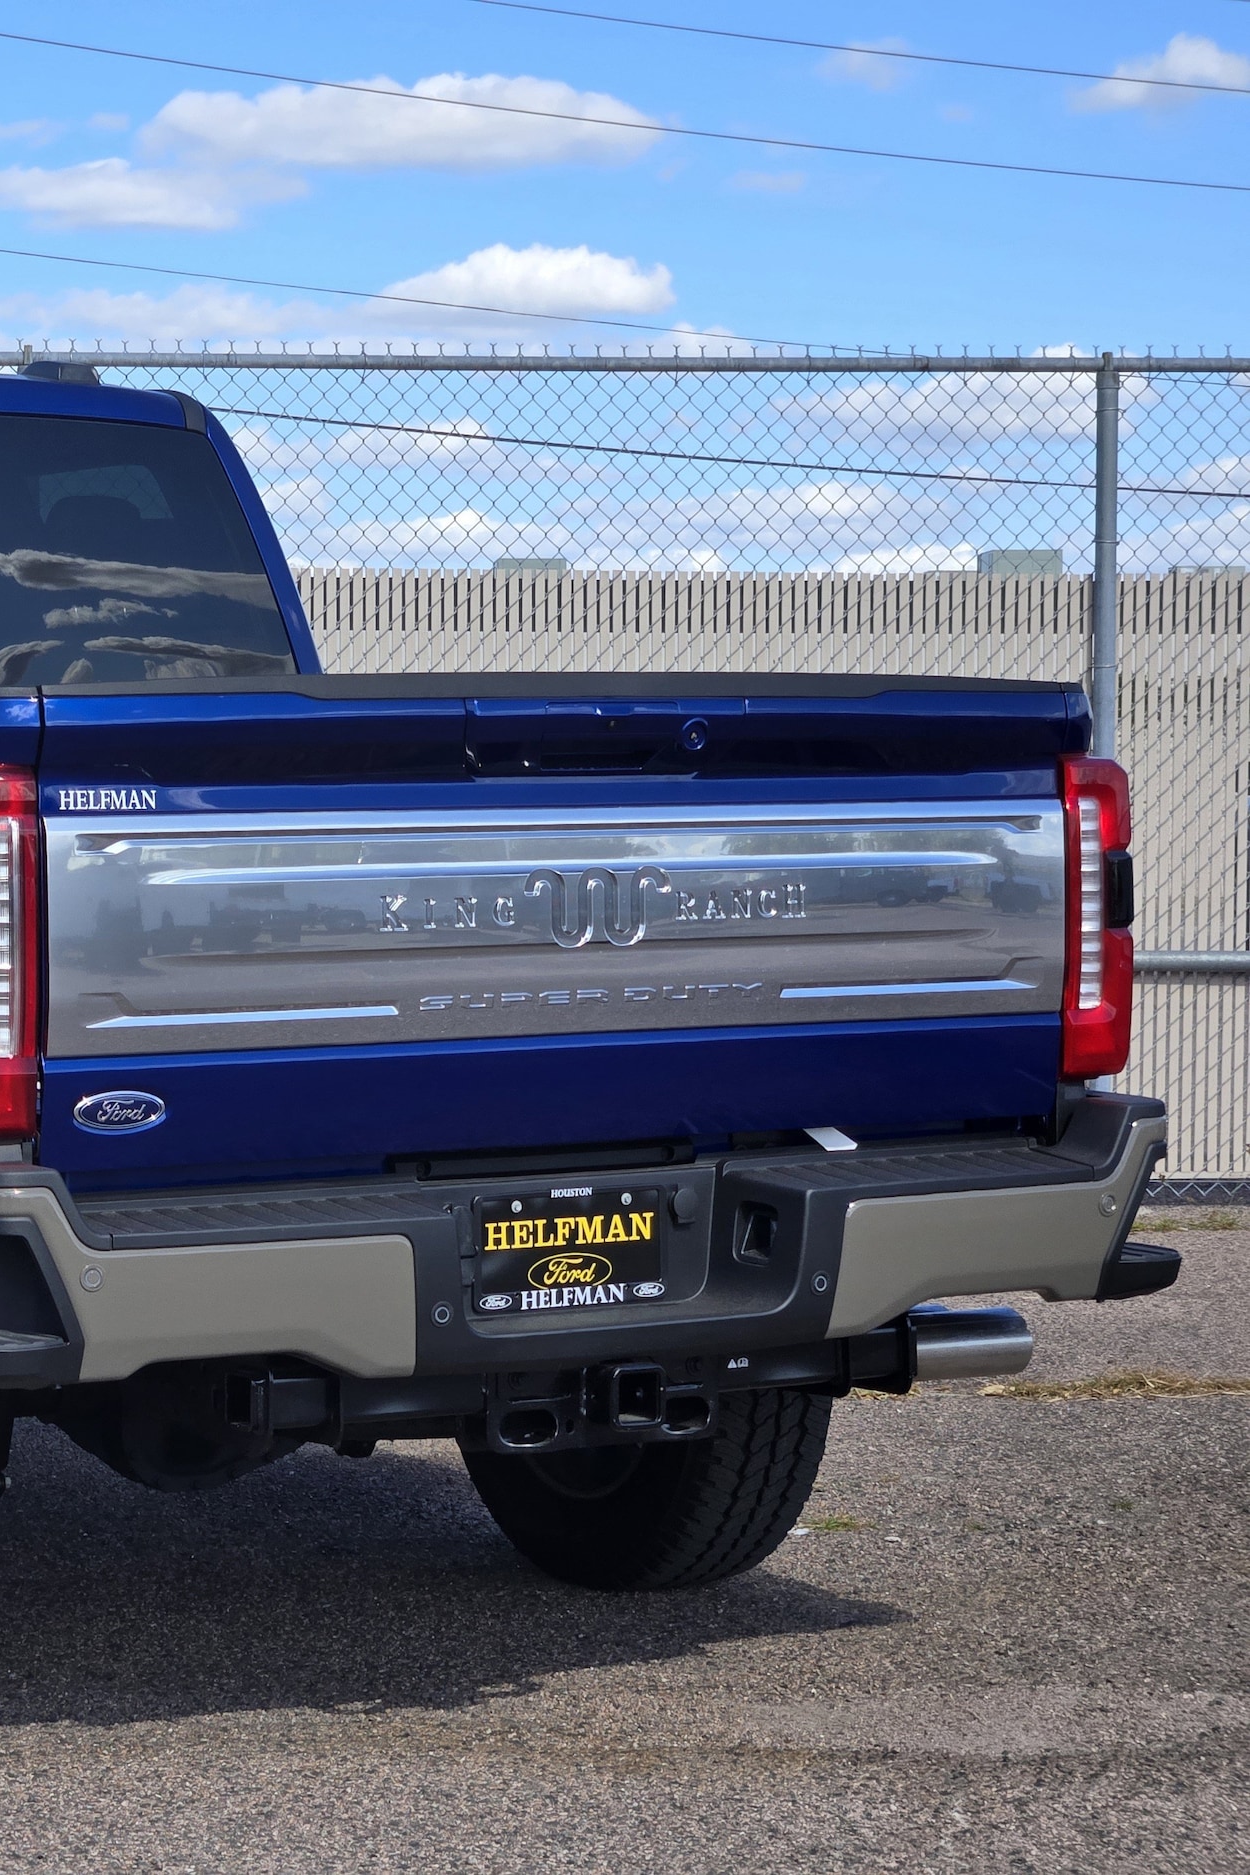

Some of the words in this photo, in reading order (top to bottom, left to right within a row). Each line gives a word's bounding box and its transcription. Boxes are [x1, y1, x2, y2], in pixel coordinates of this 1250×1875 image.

[59, 790, 157, 811] HELFMAN
[380, 894, 516, 932] KING
[675, 883, 807, 921] RANCH
[419, 989, 609, 1011] SUPER
[624, 981, 763, 1002] DUTY
[97, 1100, 147, 1122] Ford
[551, 1187, 592, 1198] HOUSTON
[484, 1212, 654, 1251] HELFMAN
[543, 1257, 597, 1285] Ford
[520, 1283, 626, 1310] HELFMAN
